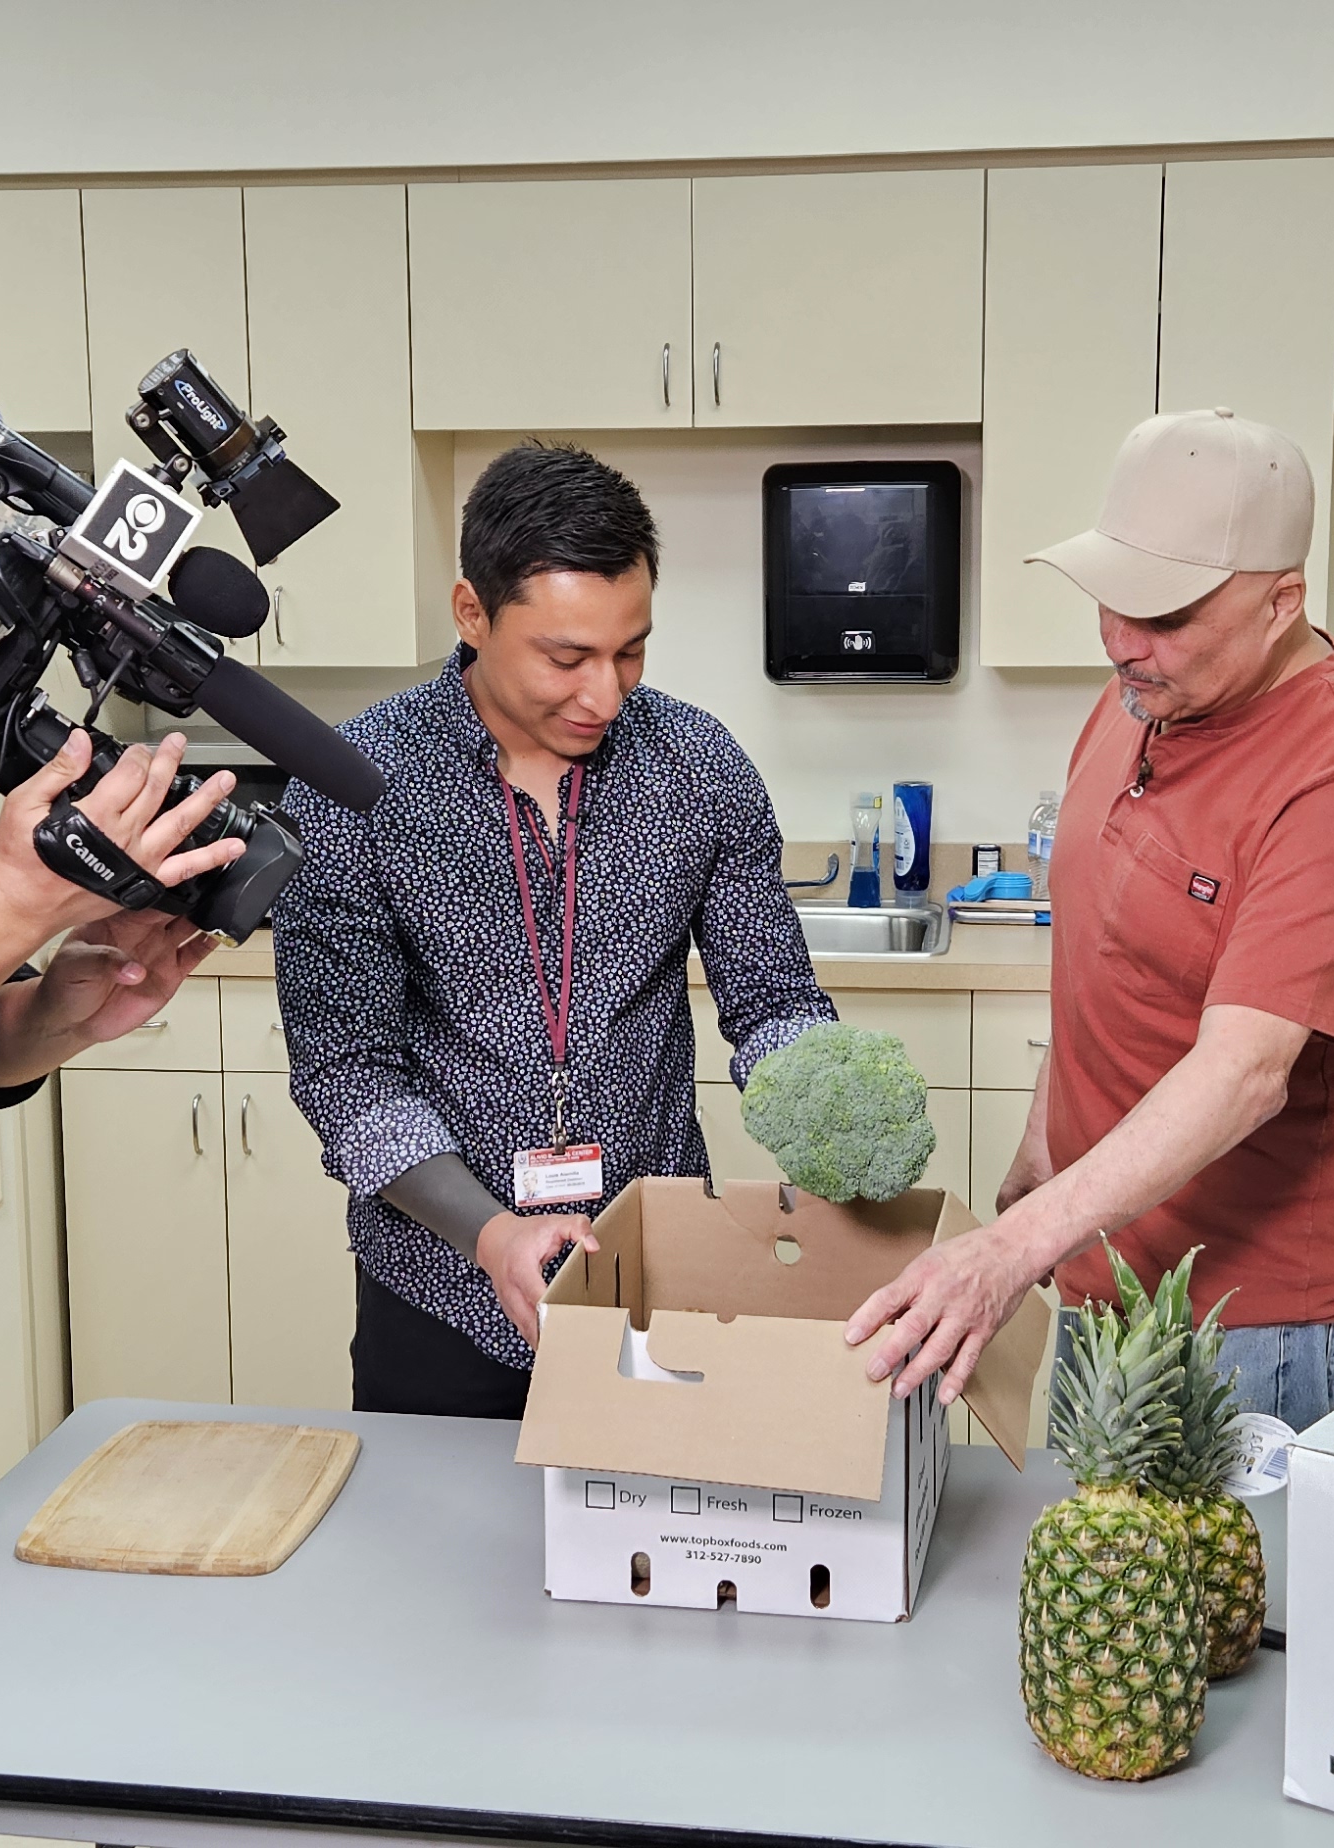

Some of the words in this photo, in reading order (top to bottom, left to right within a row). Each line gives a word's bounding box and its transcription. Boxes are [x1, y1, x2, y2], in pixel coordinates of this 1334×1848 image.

[180, 382, 222, 430] ProLight
[102, 516, 148, 561] 2
[65, 833, 115, 882] Canon
[618, 1489, 648, 1508] Dry
[706, 1496, 748, 1513] Fresh
[809, 1504, 863, 1521] Frozen
[659, 1533, 788, 1553] www.topboxfoods.com
[684, 1549, 763, 1565] 312-527-7890
